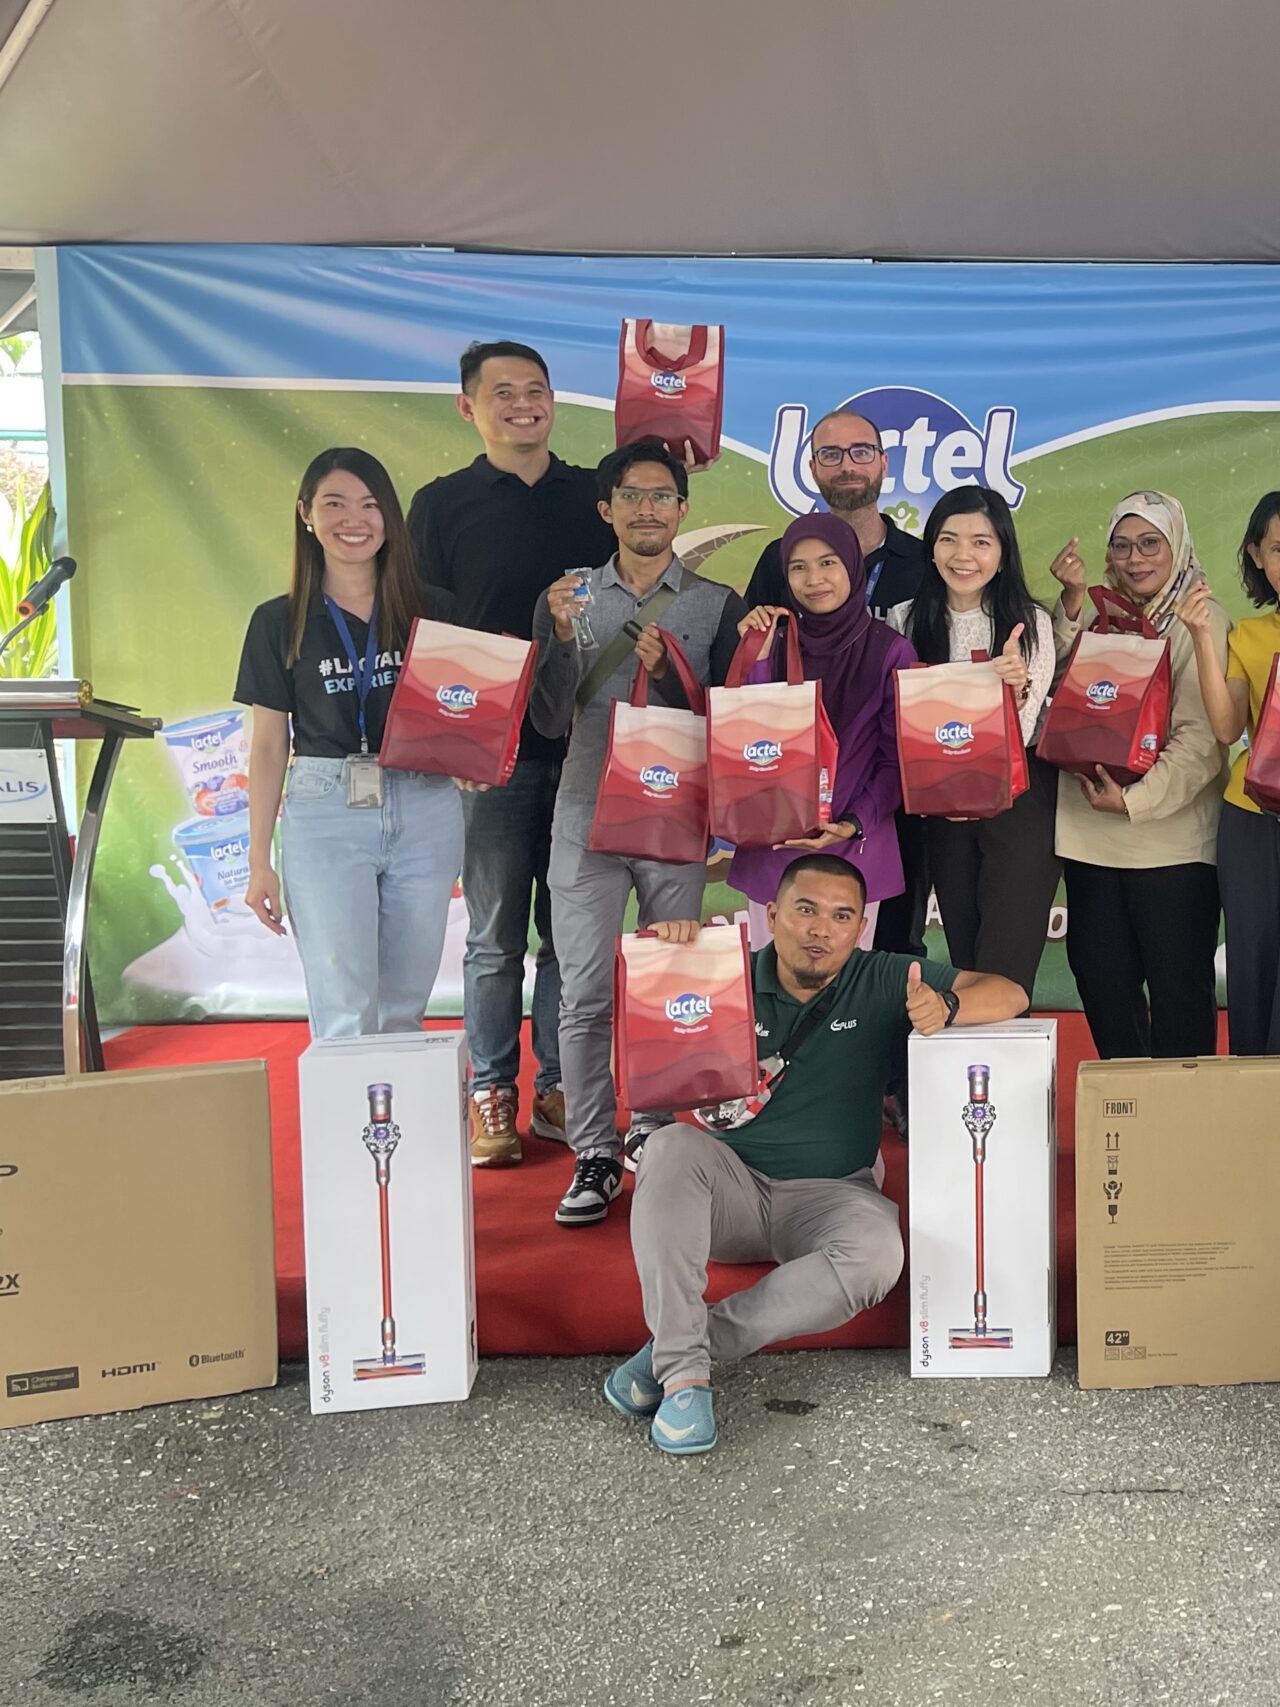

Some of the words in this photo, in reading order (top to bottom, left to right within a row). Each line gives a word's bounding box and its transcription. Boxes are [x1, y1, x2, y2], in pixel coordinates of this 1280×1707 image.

[651, 371, 687, 388] lactel
[769, 404, 1026, 515] ltel
[436, 685, 478, 706] lactel
[1086, 683, 1120, 698] lactel
[190, 731, 223, 751] lactel
[935, 724, 975, 743] lactel
[743, 742, 783, 760] lactel
[192, 752, 238, 774] Smooth
[640, 766, 679, 787] lactel
[0, 780, 40, 793] LIS
[210, 840, 245, 861] lactel
[665, 996, 713, 1020] lactel
[1105, 1102, 1134, 1115] FRONT
[920, 1320, 929, 1333] v8
[201, 1349, 245, 1364] Bluetooth
[319, 1354, 330, 1368] v8
[920, 1336, 932, 1367] dyson
[101, 1361, 157, 1378] HDMI
[320, 1370, 334, 1403] dyson
